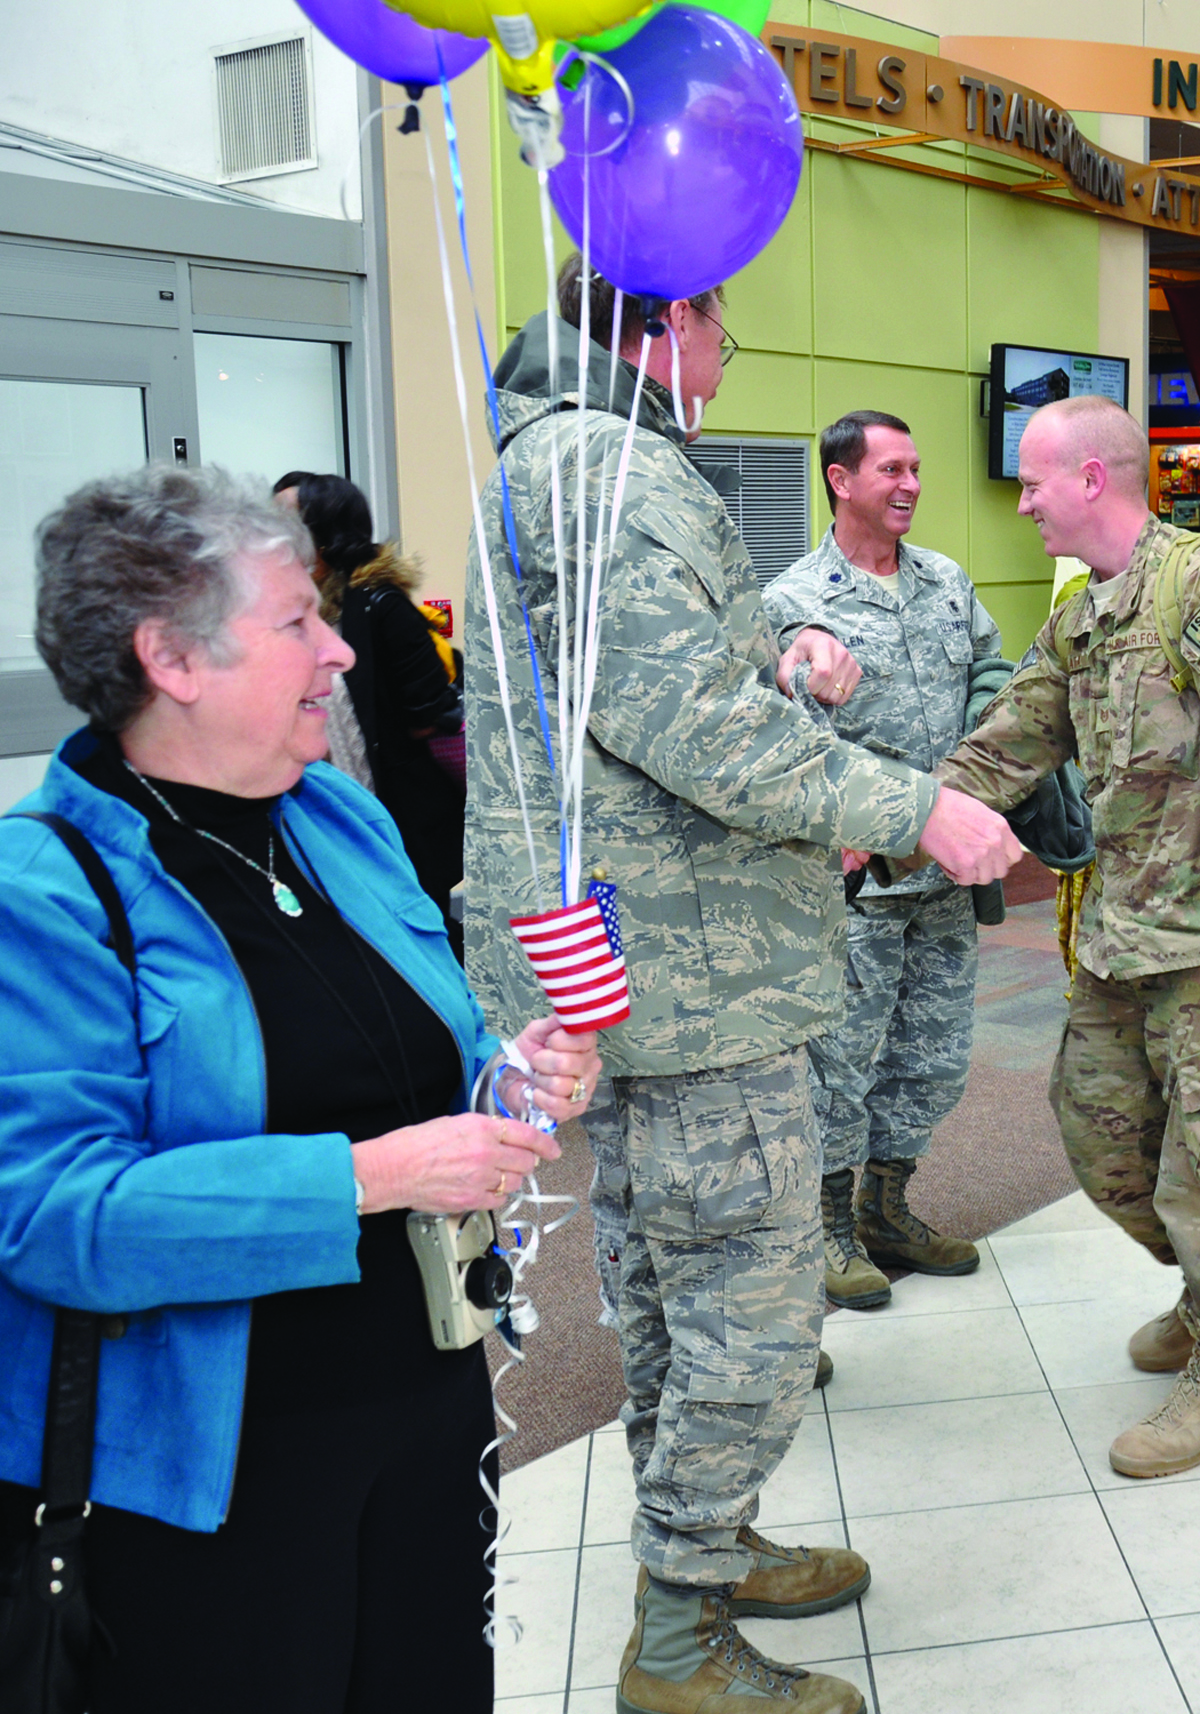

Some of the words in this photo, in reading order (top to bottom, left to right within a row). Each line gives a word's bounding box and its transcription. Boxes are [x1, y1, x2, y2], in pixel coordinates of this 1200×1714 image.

[771, 35, 907, 114] TELS
[959, 75, 1126, 206] TRANSPOATION
[841, 635, 865, 649] LEN
